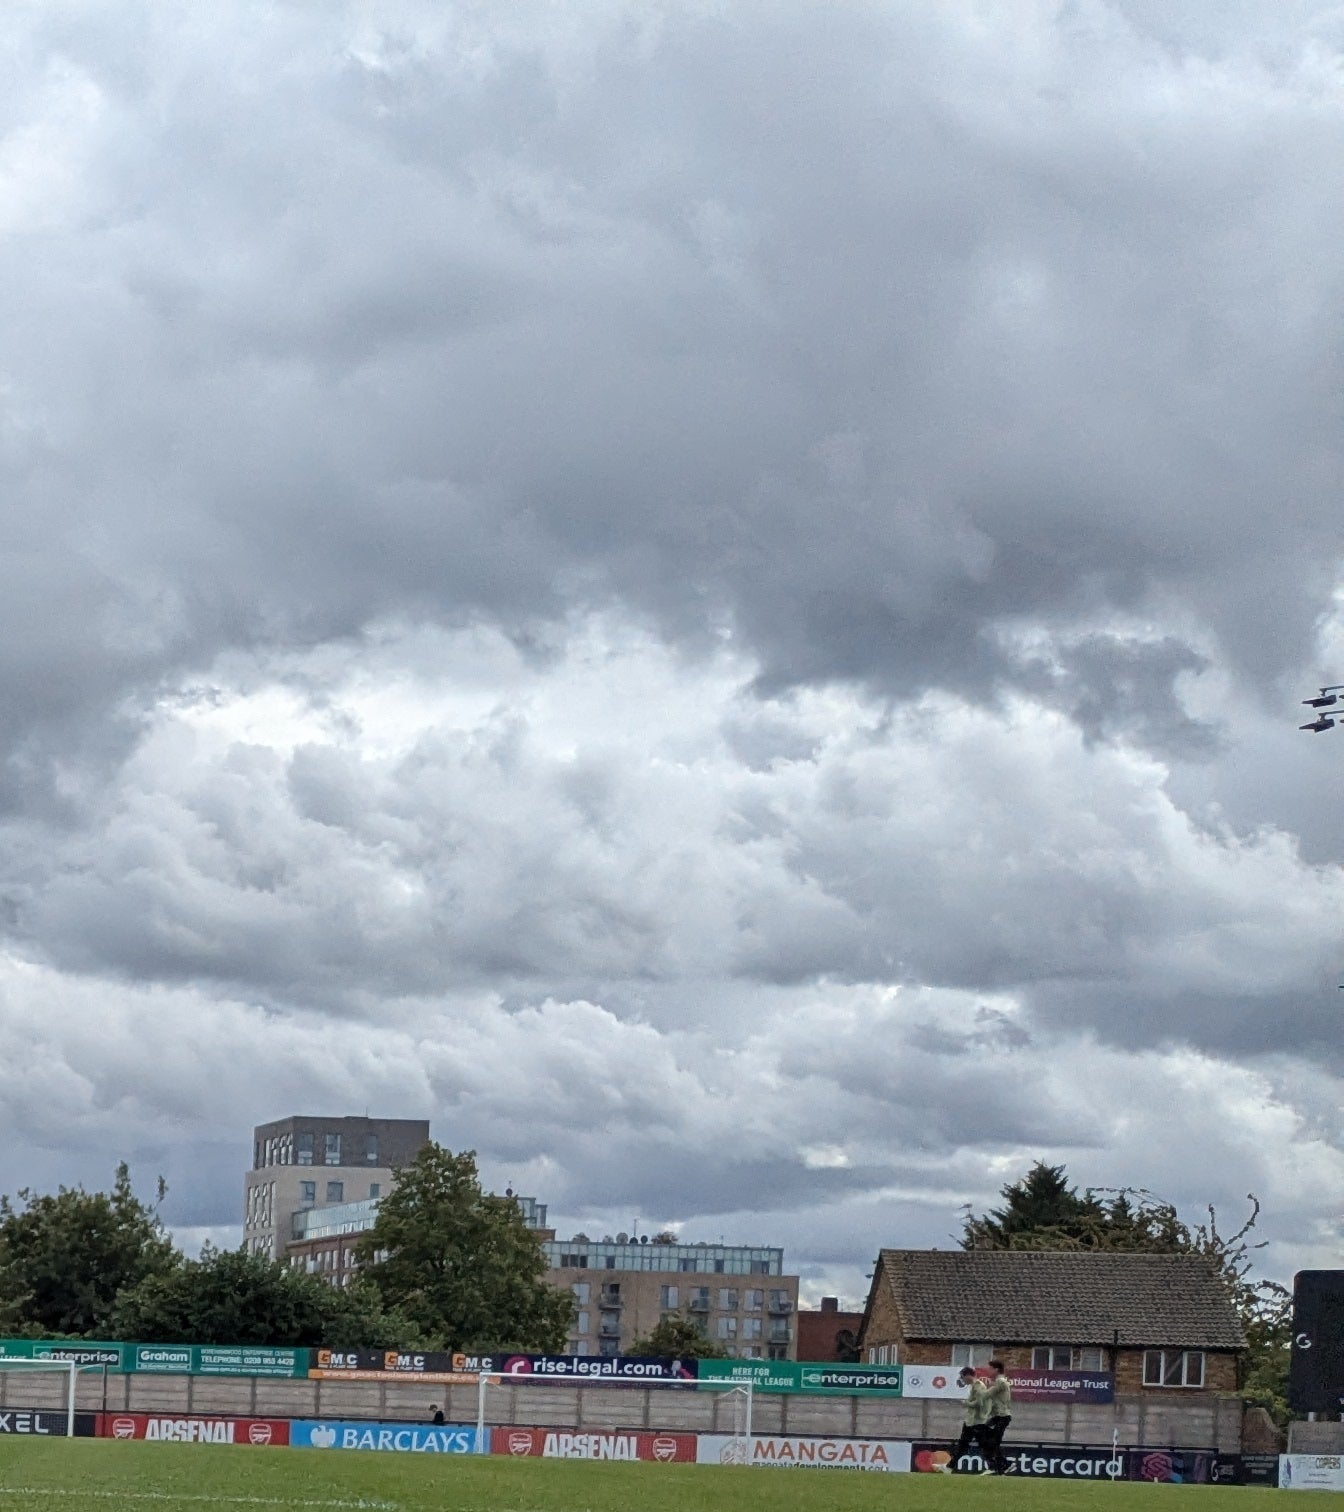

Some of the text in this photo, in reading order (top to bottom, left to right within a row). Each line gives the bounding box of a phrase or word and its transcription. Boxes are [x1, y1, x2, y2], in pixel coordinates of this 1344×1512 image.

[39, 1350, 119, 1363] enterprise
[140, 1350, 188, 1361] Graham
[533, 1357, 662, 1377] rise-legal.com
[764, 1377, 794, 1387] LEAGUE
[809, 1372, 898, 1387] enterprise
[1044, 1378, 1081, 1390] League
[1083, 1379, 1109, 1389] Trust
[145, 1419, 235, 1443] ARSENAL
[342, 1429, 469, 1454] BARCLAYS
[543, 1434, 640, 1461] ARSENAL
[753, 1440, 889, 1464] MANGATA
